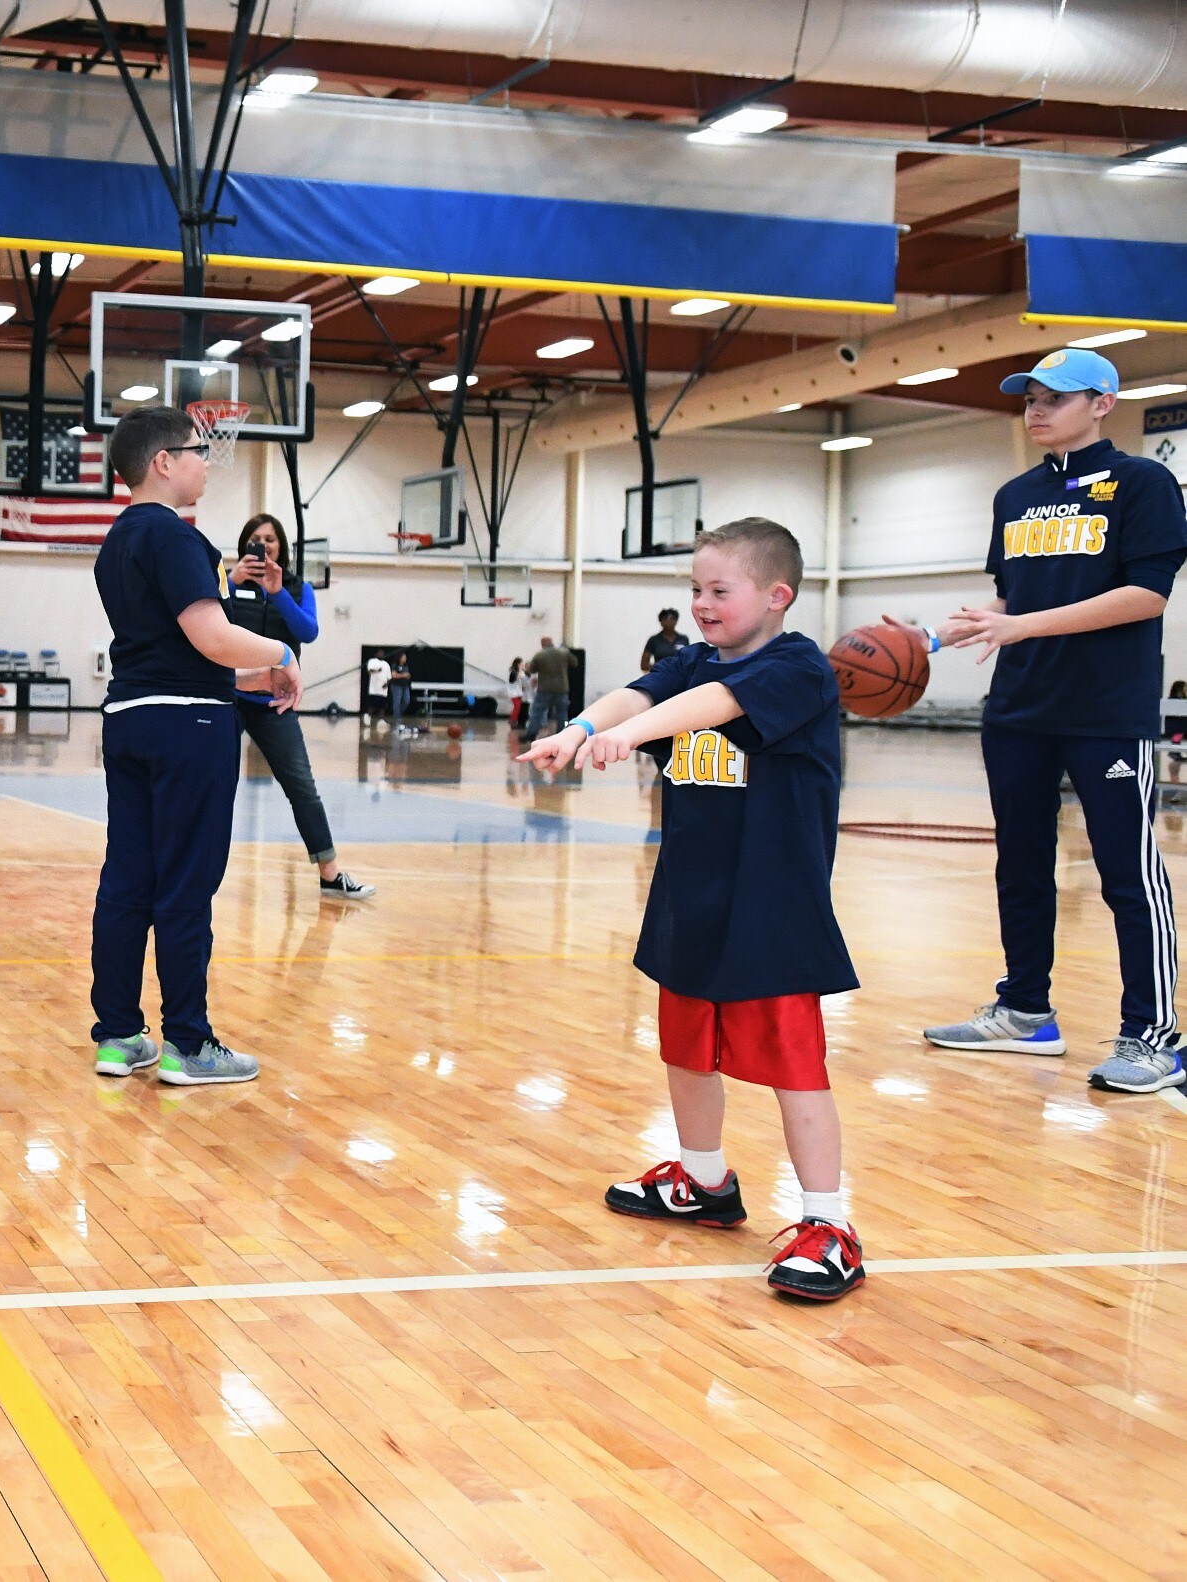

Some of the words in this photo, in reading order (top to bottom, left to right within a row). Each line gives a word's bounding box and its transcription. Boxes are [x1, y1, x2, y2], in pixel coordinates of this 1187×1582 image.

[1021, 503, 1081, 520] JUNIOR
[1004, 514, 1109, 560] NUGGETS
[663, 728, 749, 788] GGE
